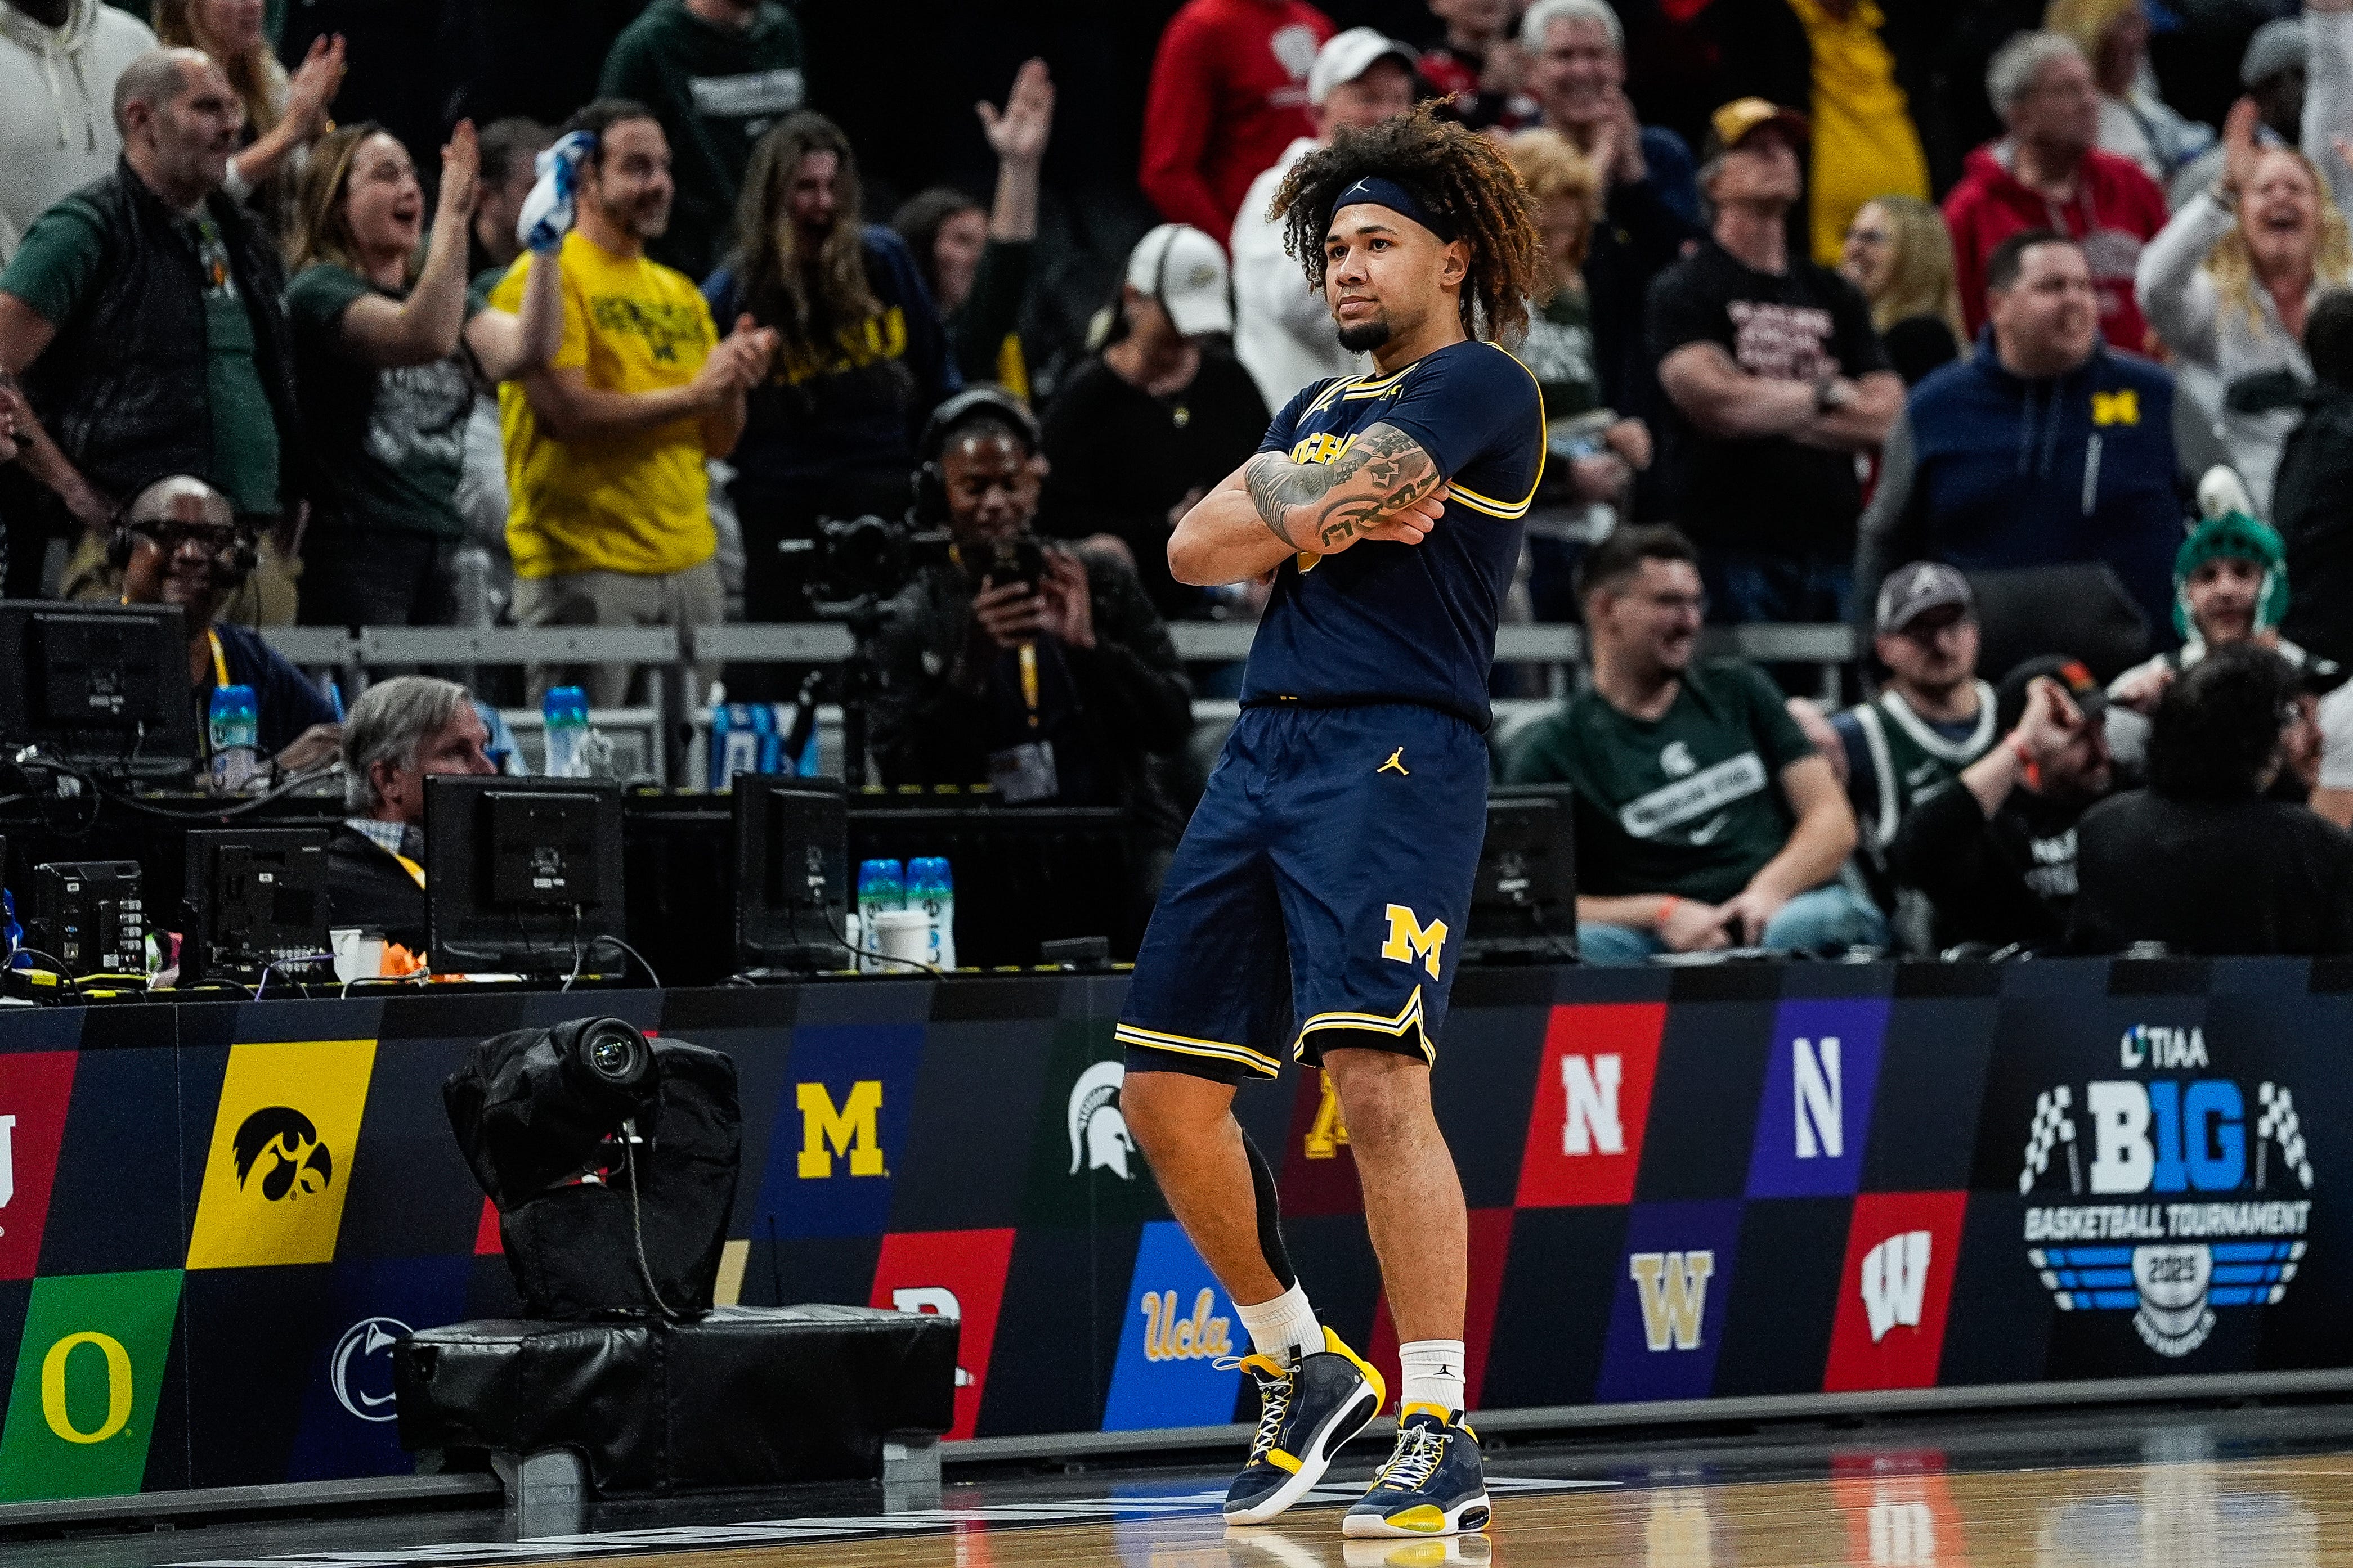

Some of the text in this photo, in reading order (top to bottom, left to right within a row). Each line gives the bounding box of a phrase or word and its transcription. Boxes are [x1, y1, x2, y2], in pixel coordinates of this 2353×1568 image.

[1382, 903, 1449, 981] M
[1793, 1037, 1843, 1158] N
[2146, 1025, 2210, 1070] TIAA
[796, 1080, 884, 1179] M
[1561, 1054, 1625, 1156] N
[2024, 1200, 2312, 1241] BASKETBALL TOURNAMENT
[2149, 1255, 2197, 1283] 2025
[1630, 1250, 1715, 1351] W
[1861, 1229, 1932, 1343] W
[42, 1331, 133, 1444] O
